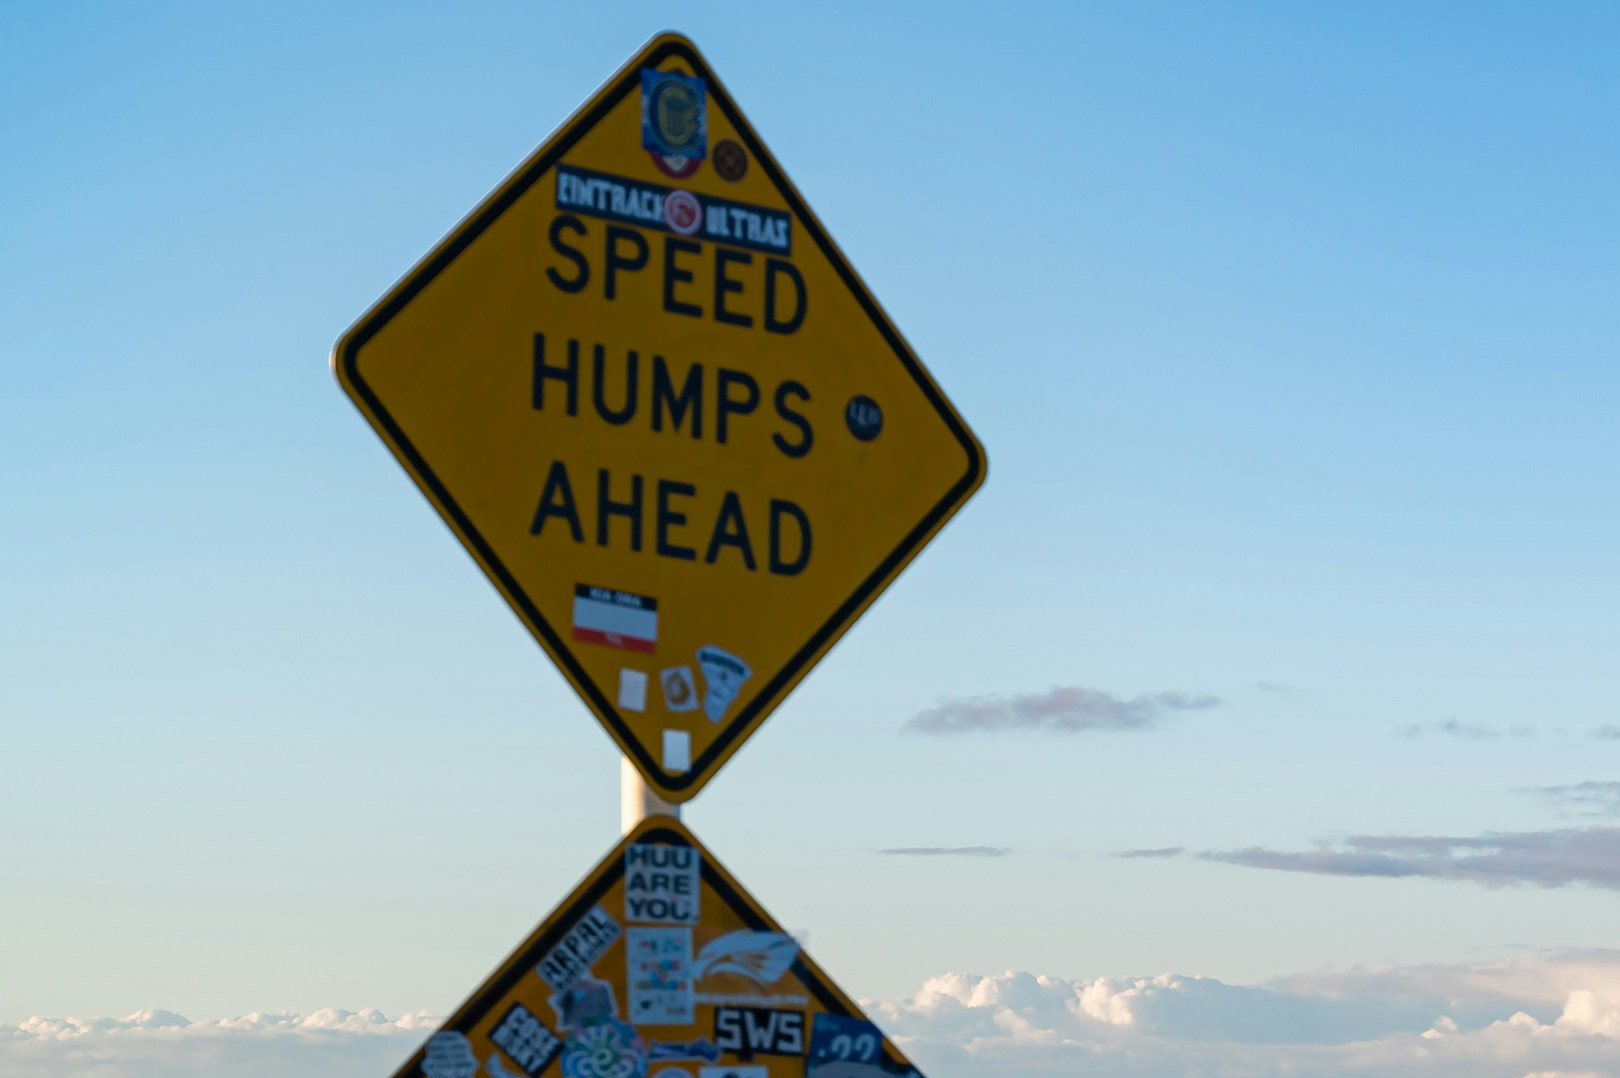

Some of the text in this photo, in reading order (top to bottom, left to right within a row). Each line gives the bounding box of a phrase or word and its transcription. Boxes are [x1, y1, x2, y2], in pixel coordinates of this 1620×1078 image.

[545, 214, 808, 335] SPEED
[531, 332, 815, 458] HUMPS
[529, 461, 814, 577] AHEAD
[628, 872, 691, 895] ARE
[628, 898, 691, 921] YOU
